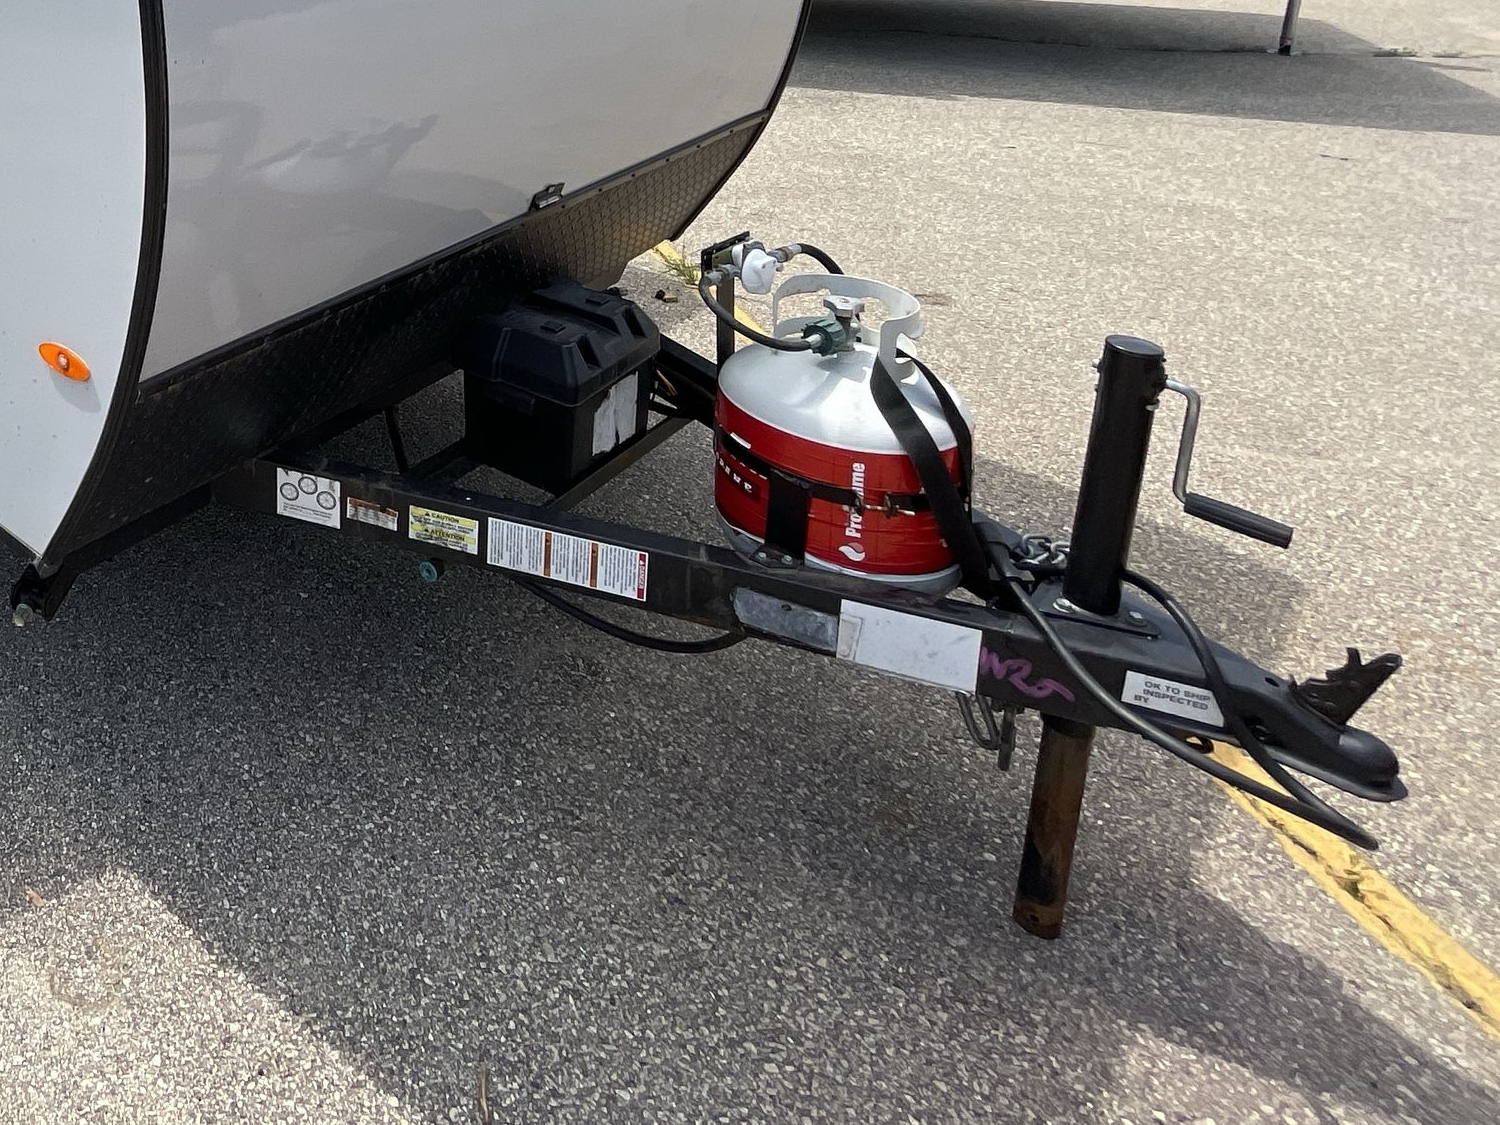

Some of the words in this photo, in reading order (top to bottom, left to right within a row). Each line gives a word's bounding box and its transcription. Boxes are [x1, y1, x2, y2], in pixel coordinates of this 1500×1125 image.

[845, 462, 866, 538] Proame
[431, 512, 460, 524] CAUTION
[429, 529, 465, 542] ATTENTION
[1134, 694, 1150, 704] BY
[1143, 688, 1209, 710] INSPECTED
[1144, 680, 1161, 691] OK
[1165, 685, 1181, 695] TO
[1184, 690, 1211, 701] SHIP
